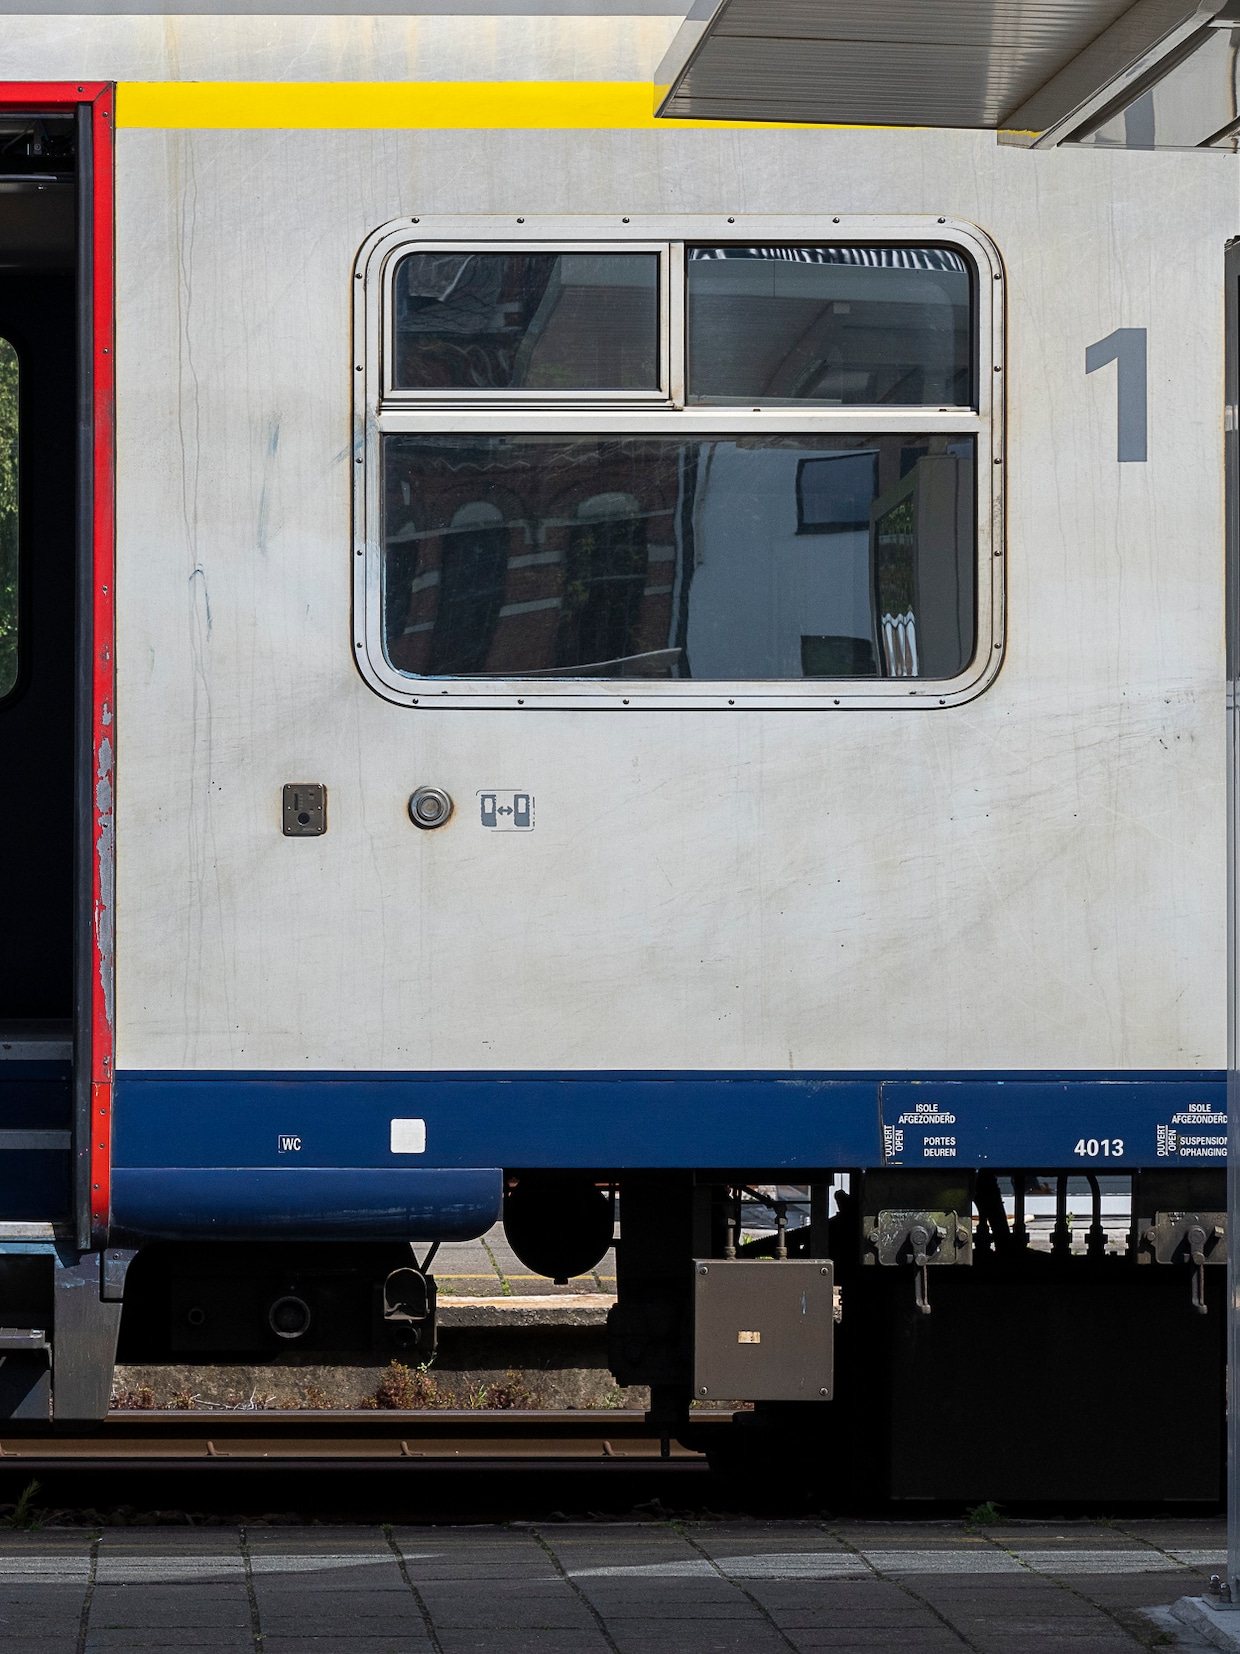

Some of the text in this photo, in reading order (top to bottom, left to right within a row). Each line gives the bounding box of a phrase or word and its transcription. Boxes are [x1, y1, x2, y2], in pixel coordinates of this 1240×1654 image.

[1085, 328, 1147, 462] 1
[915, 1103, 939, 1113] ISOLE
[1188, 1103, 1212, 1113] ISOLE
[898, 1115, 956, 1124] AFGEZONDERD
[282, 1137, 302, 1151] WC
[883, 1124, 893, 1157] OUVERT
[895, 1129, 904, 1152] OPEN
[923, 1137, 956, 1146] PORTES
[1156, 1124, 1166, 1157] OUVERT
[1168, 1129, 1177, 1151] OPEN
[923, 1148, 956, 1157] DEUREN
[1074, 1138, 1124, 1157] 4013
[1179, 1148, 1228, 1157] OPHANGING
